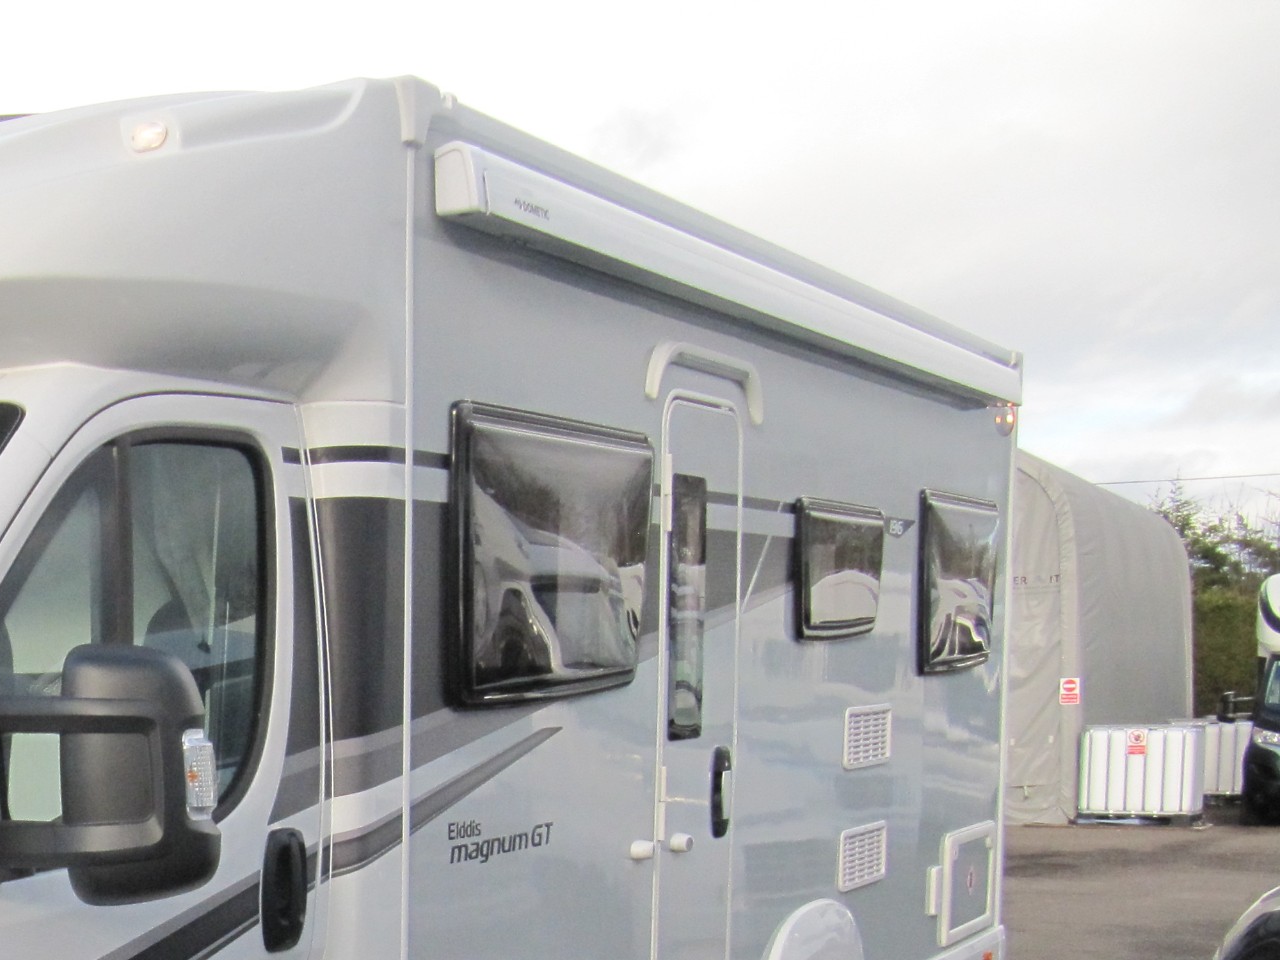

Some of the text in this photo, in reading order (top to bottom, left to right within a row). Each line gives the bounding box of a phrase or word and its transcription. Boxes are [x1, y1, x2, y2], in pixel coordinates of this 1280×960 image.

[447, 820, 481, 840] Elddis
[450, 822, 553, 864] magnum GT
